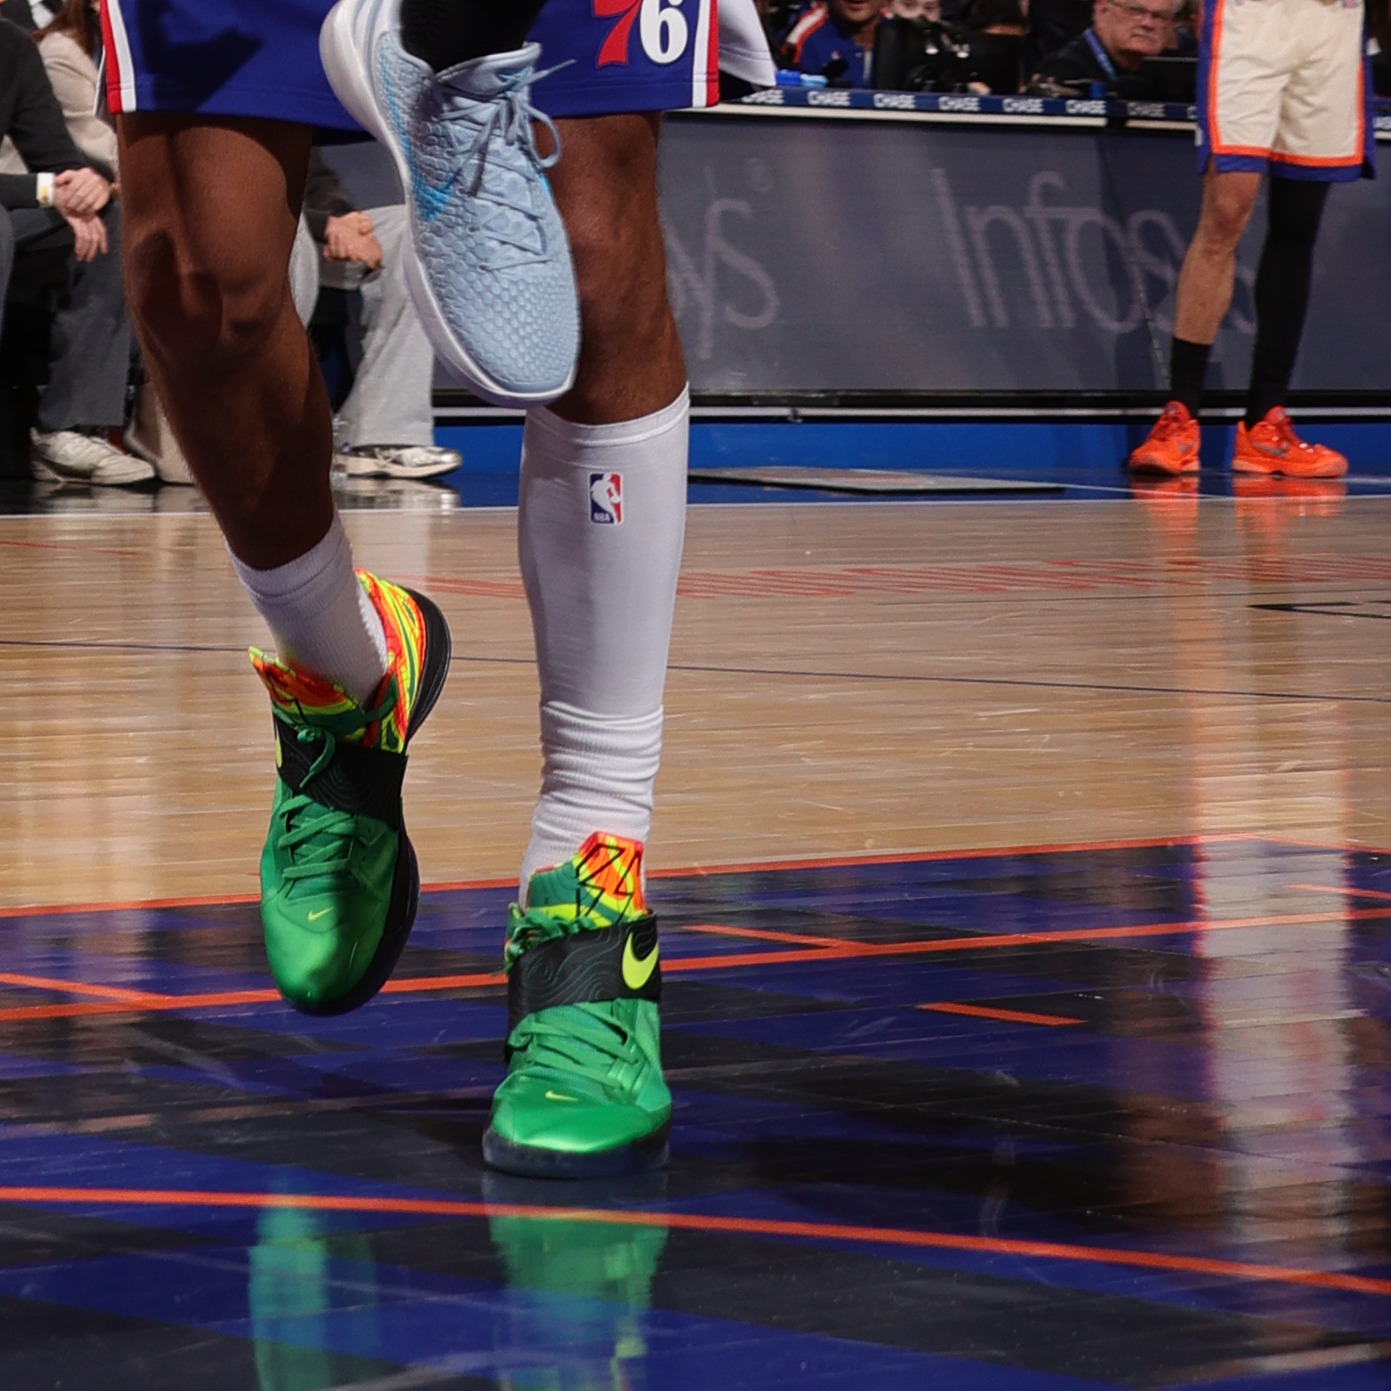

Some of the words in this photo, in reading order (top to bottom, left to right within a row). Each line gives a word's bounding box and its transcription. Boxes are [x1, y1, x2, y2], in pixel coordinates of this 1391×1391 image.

[807, 91, 851, 107] CHASE
[873, 93, 916, 109] CHASE
[938, 96, 981, 112] CHASE
[1002, 98, 1045, 114] CHASE
[1065, 100, 1108, 115] CHASE
[1127, 102, 1165, 118] CHASE
[929, 168, 1257, 361] Infos
